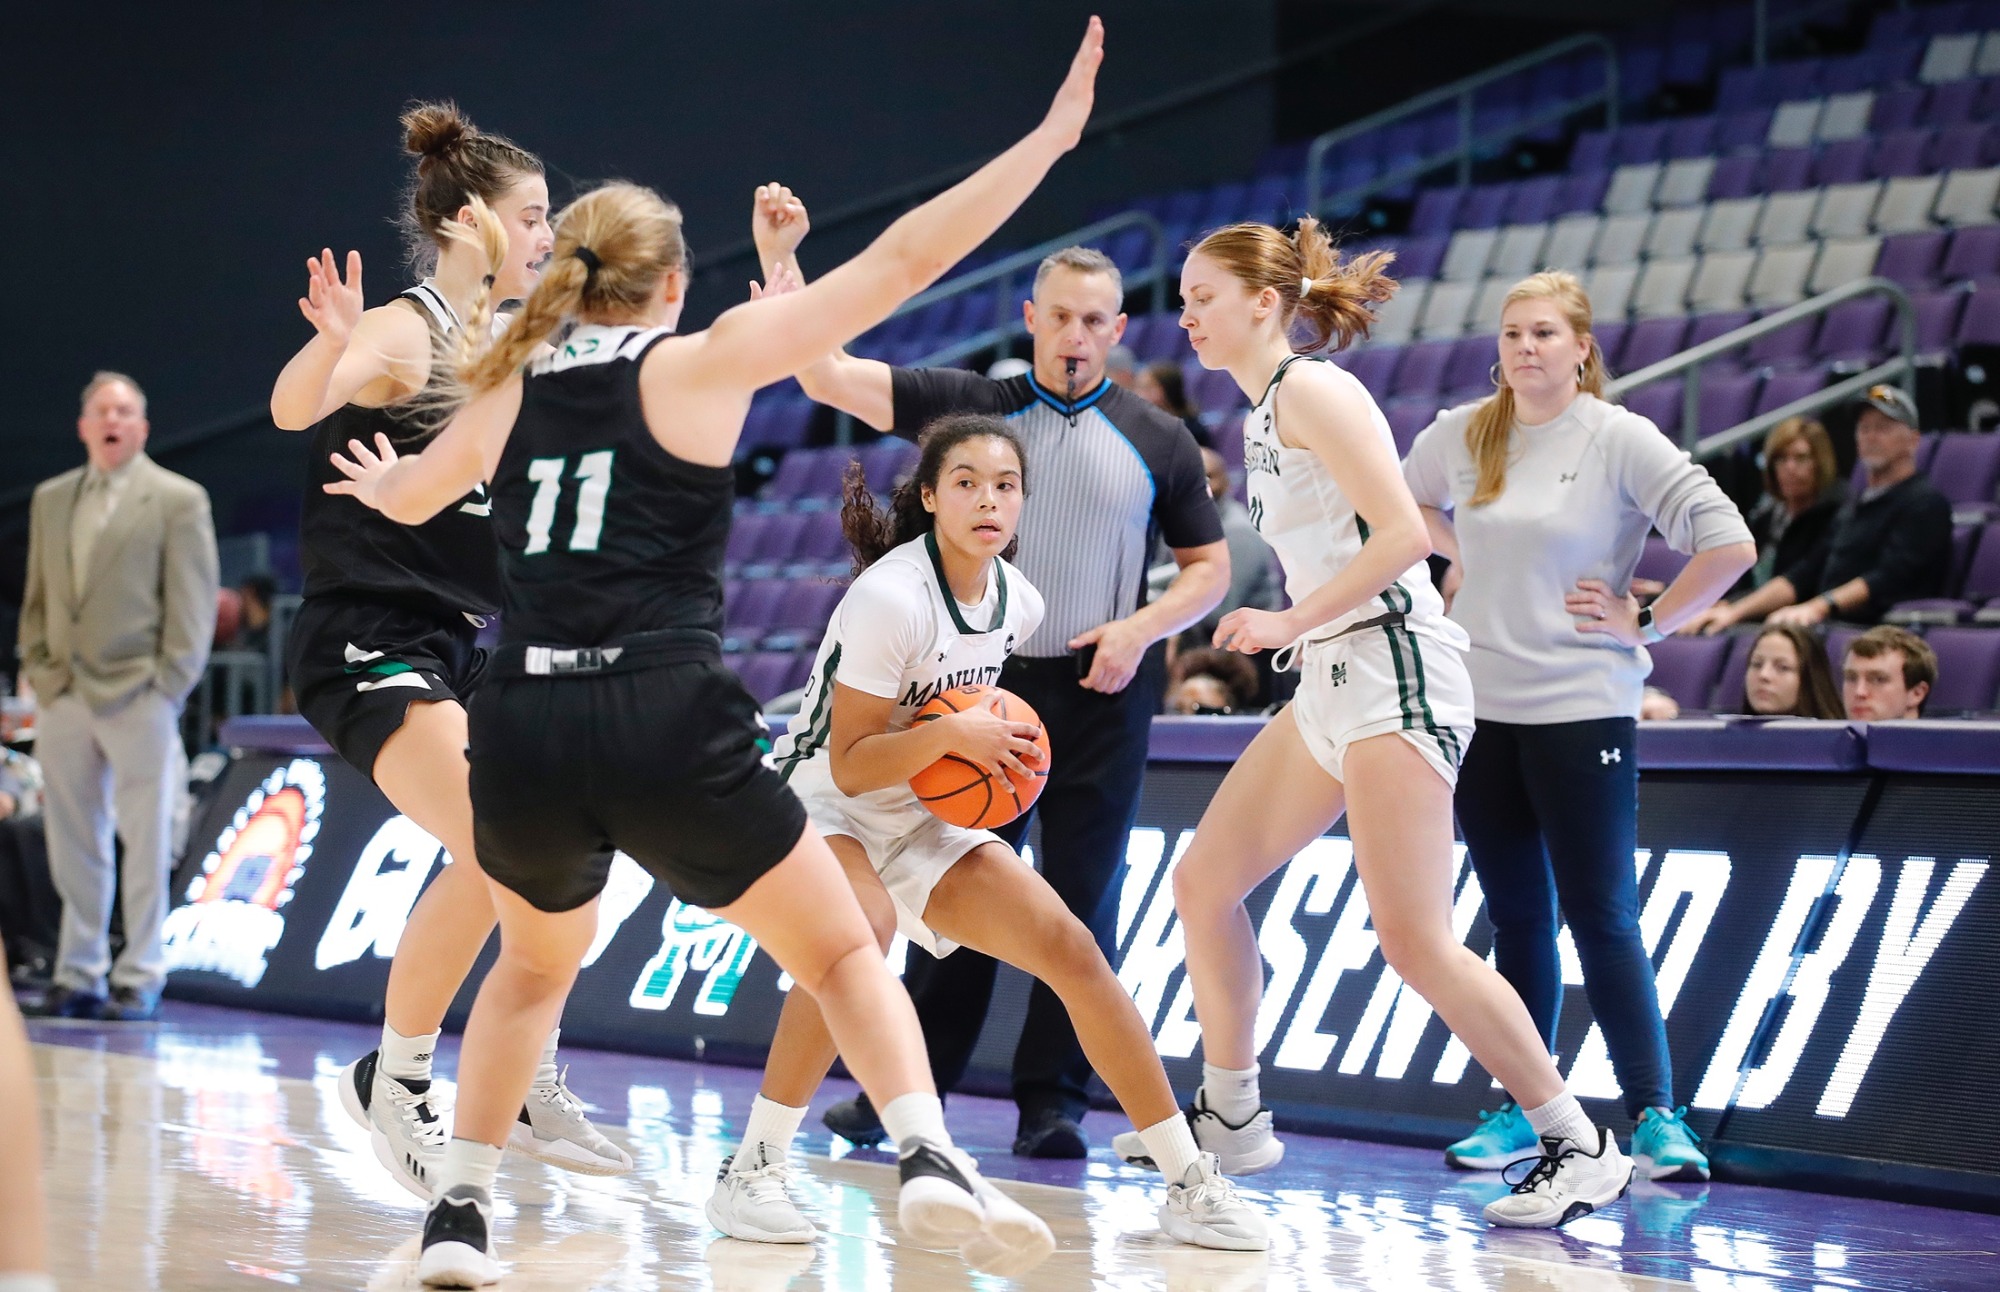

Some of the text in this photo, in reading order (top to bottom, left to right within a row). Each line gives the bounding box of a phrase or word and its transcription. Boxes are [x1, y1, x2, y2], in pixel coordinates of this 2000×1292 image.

[523, 449, 615, 556] 11
[898, 665, 1002, 708] MANHAT
[1691, 853, 1990, 1119] BY
